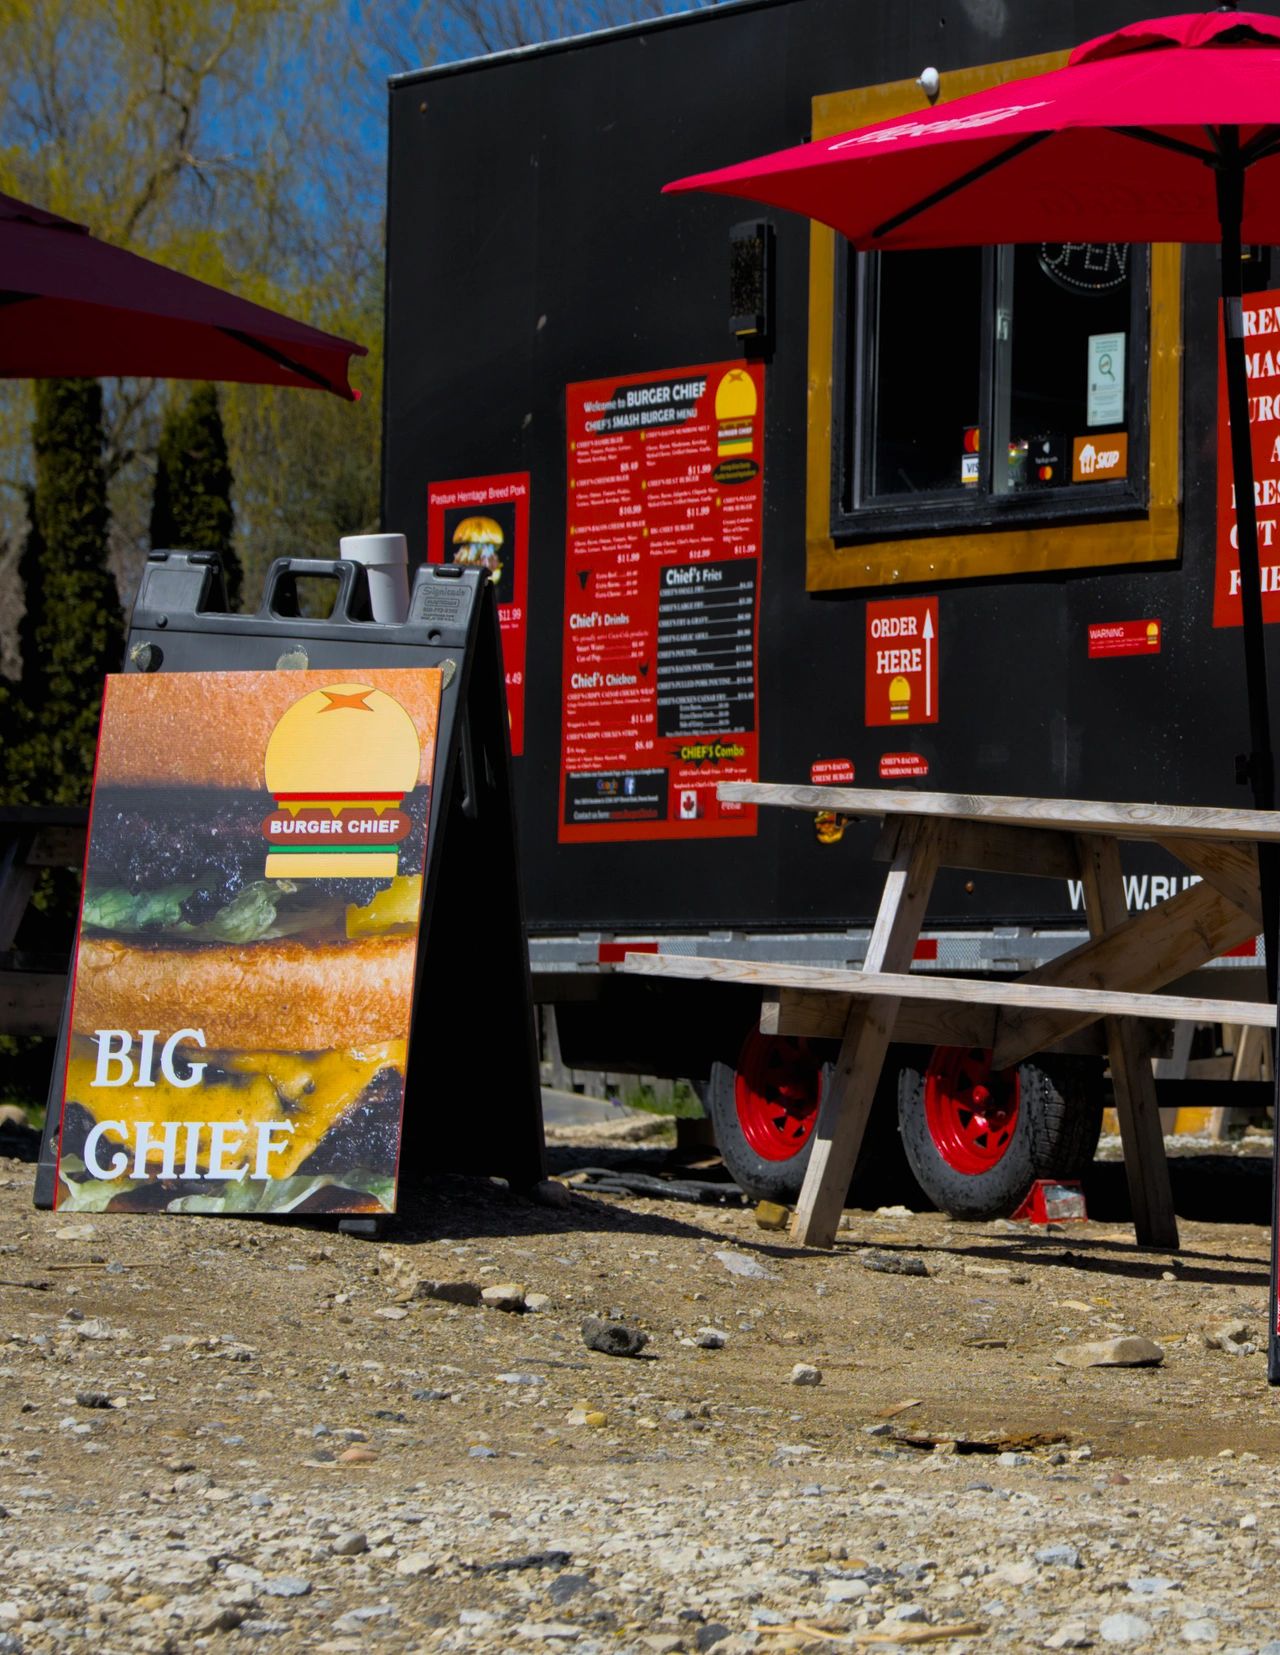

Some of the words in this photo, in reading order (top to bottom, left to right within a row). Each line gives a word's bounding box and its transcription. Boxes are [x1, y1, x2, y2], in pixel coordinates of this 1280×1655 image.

[584, 400, 617, 413] Welcome
[618, 398, 626, 409] to
[627, 387, 670, 407] BURGER
[673, 381, 706, 401] CHIEF
[585, 418, 612, 432] CHIEF'S
[613, 414, 640, 429] SMASH
[641, 410, 675, 425] BURGER
[676, 408, 697, 420] MENU
[967, 464, 979, 473] VIS
[1096, 451, 1120, 470] SKIP
[488, 485, 508, 500] Breed
[509, 484, 526, 497] Pork
[666, 566, 701, 585] Chief's
[702, 569, 723, 582] Fries
[570, 612, 602, 629] Chief's
[604, 613, 630, 626] Drinks
[871, 616, 918, 638] ORDER
[1089, 627, 1125, 639] WARNING
[876, 648, 922, 674] HERE
[571, 672, 603, 689] Chief's
[606, 673, 637, 686] Chicken
[680, 745, 714, 760] CHIEF'S
[714, 743, 745, 758] Combo
[270, 818, 343, 835] BURGER
[347, 818, 399, 834] CHIEF
[91, 1028, 208, 1088] BIG
[84, 1119, 295, 1181] CHIEF
